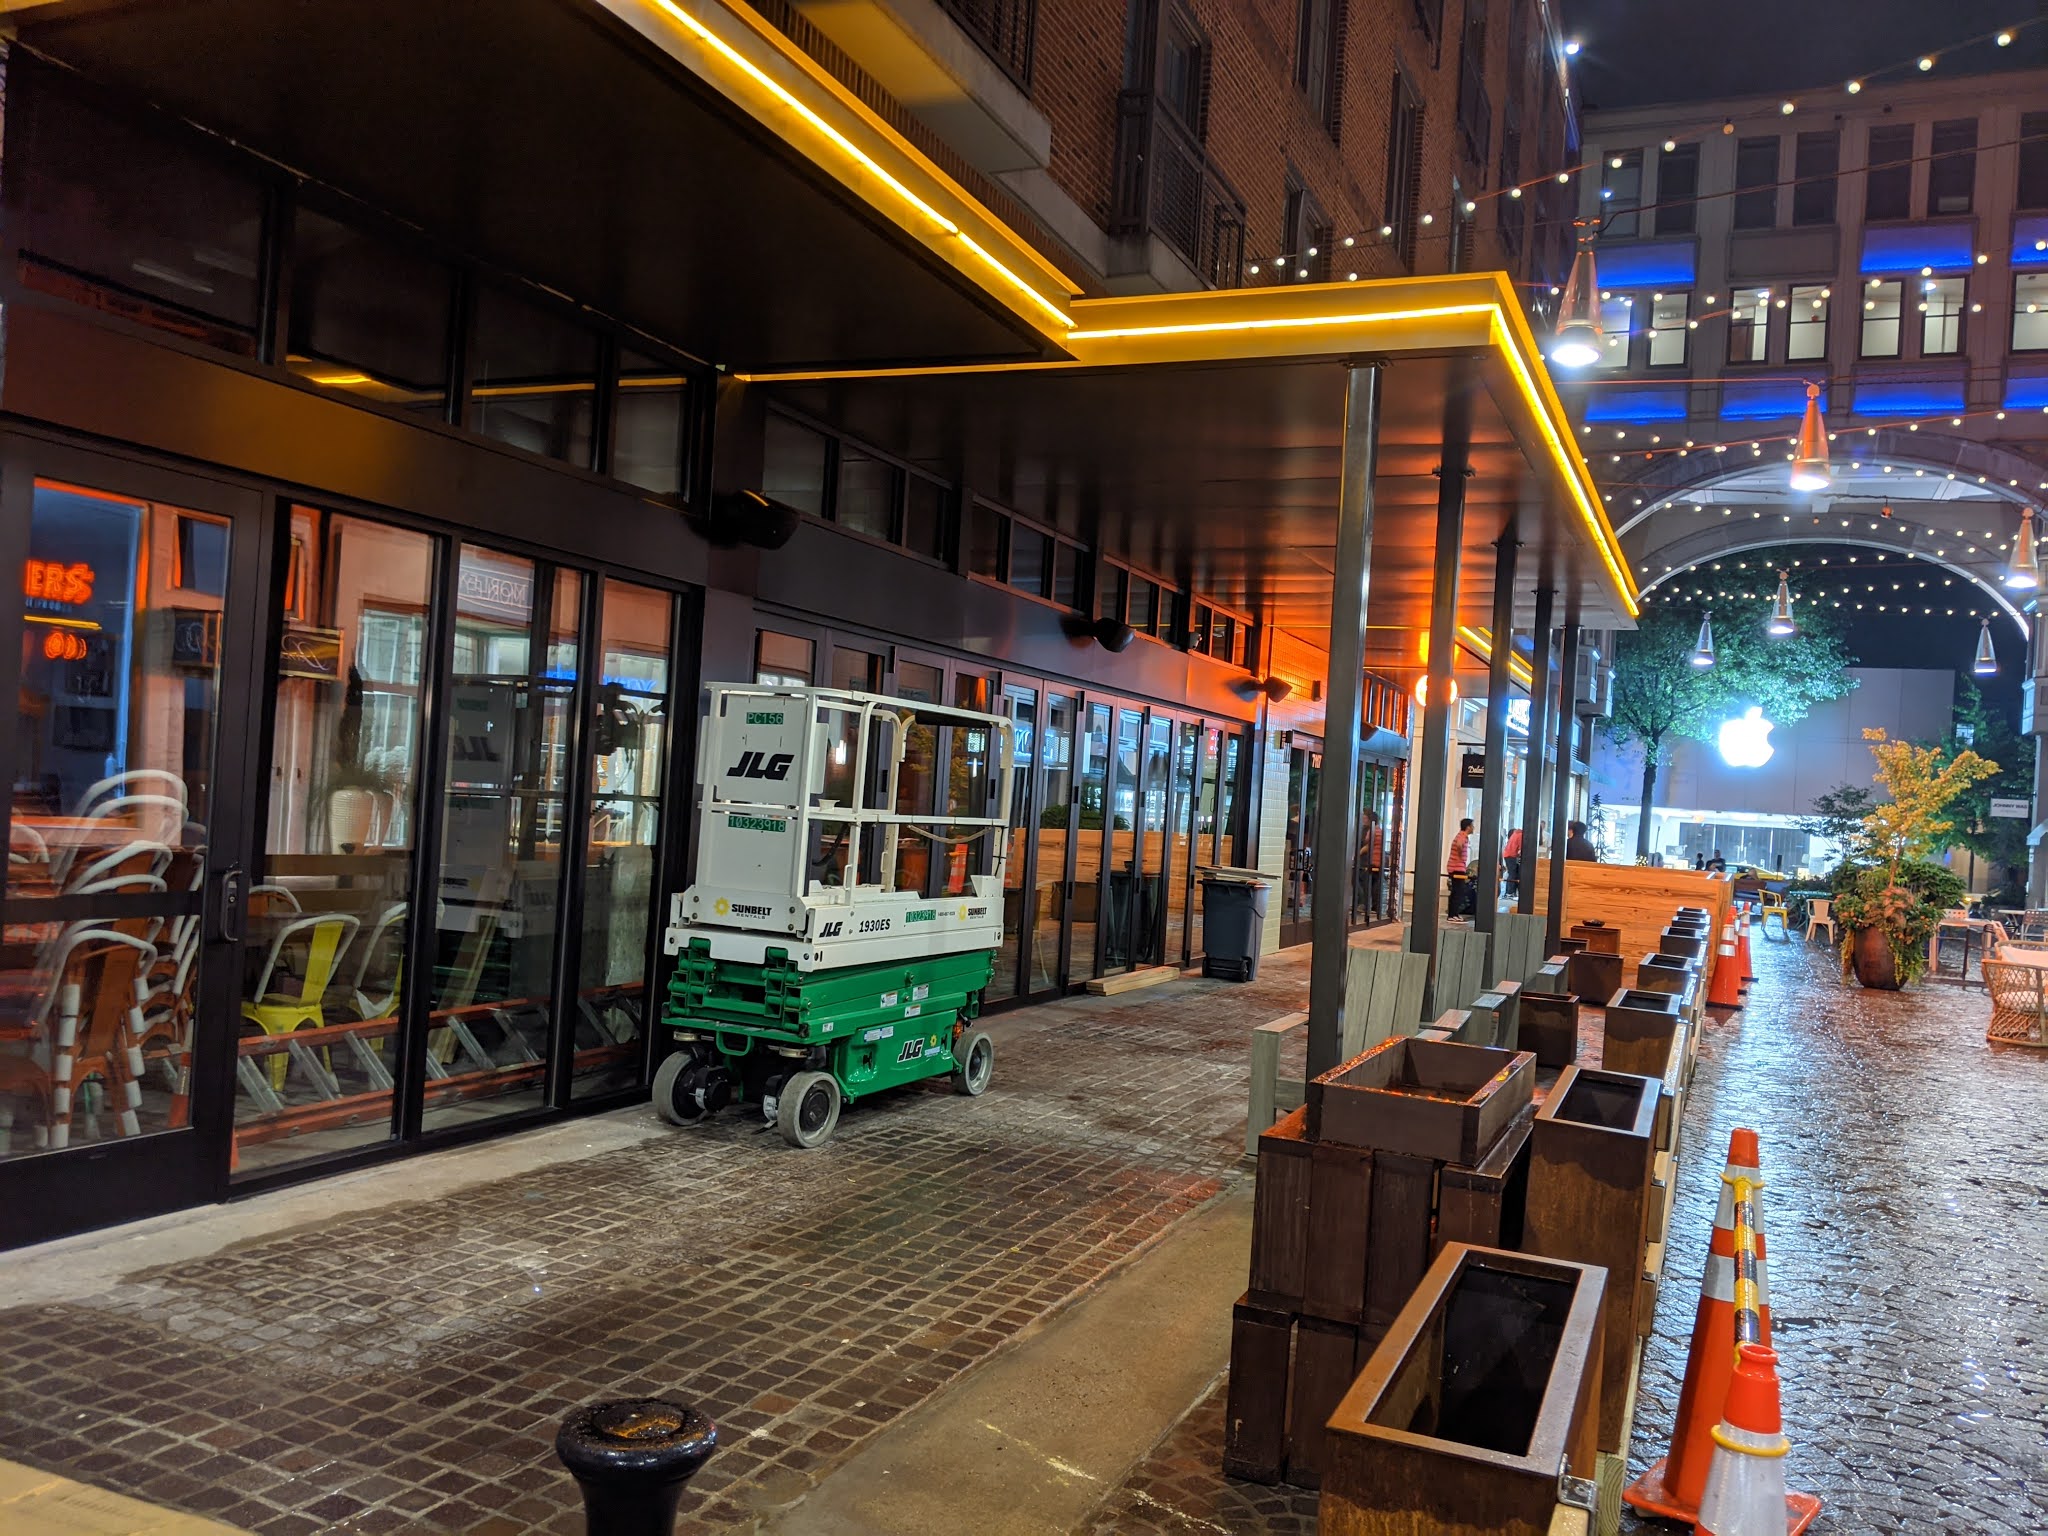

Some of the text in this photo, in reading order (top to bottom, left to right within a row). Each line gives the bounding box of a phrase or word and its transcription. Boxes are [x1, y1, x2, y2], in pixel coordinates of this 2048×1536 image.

[747, 712, 784, 725] PC156
[726, 751, 795, 781] JLG
[729, 816, 786, 832] 10323918
[731, 903, 772, 916] SUNBELT
[967, 907, 987, 916] SUNBELT
[819, 921, 843, 938] JLG
[858, 918, 891, 933] 1930ES
[897, 1038, 925, 1063] JLG
